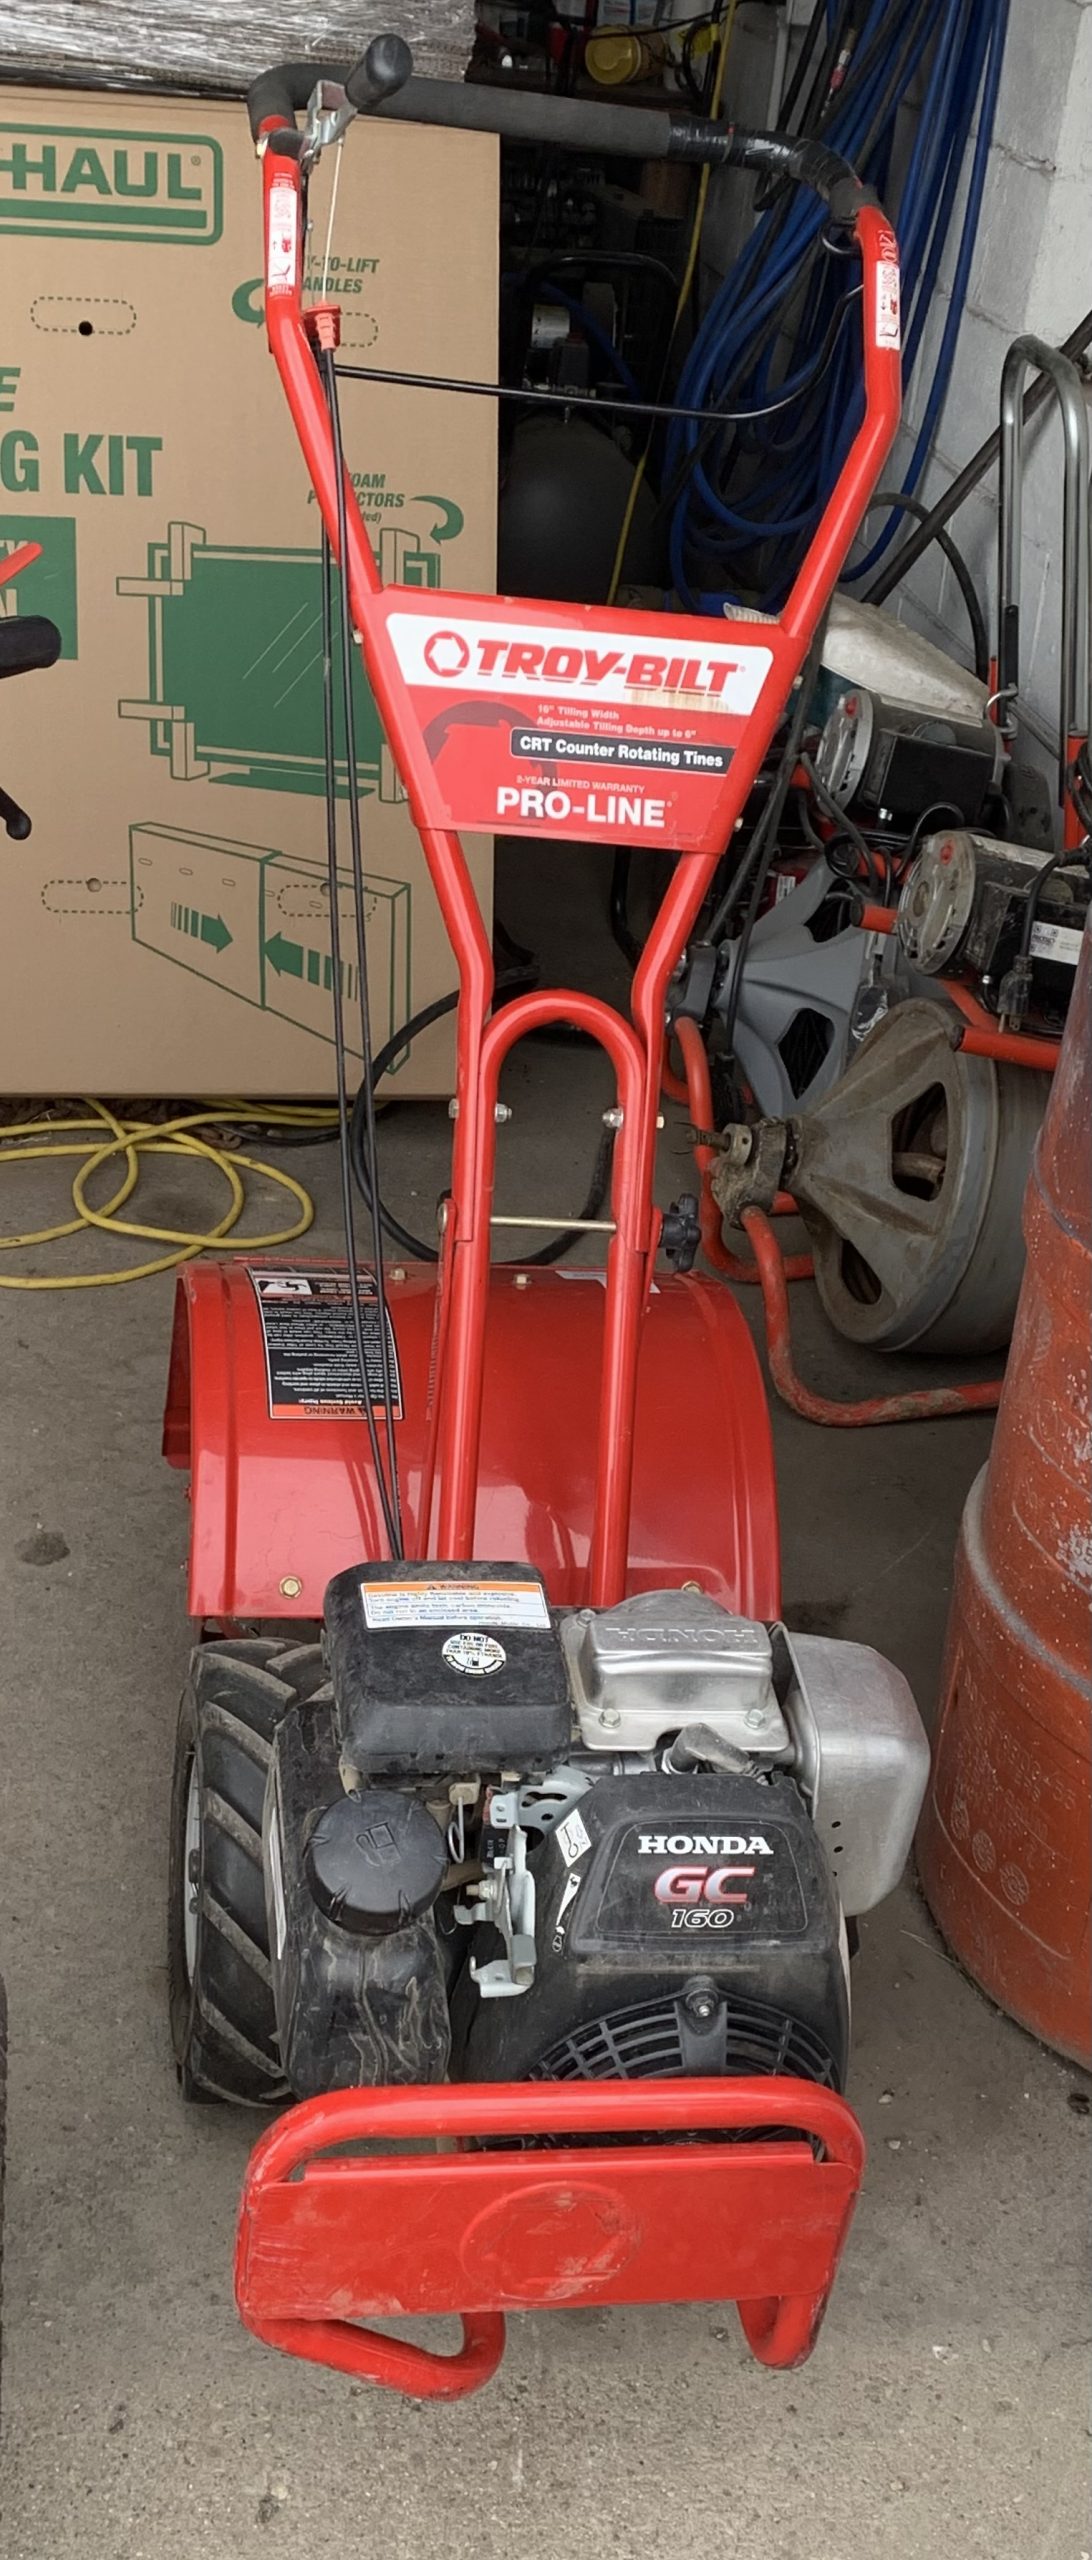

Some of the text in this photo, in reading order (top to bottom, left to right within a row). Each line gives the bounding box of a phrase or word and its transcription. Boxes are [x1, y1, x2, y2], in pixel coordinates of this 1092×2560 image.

[302, 276, 362, 293] ANDLES
[64, 433, 163, 497] KIT
[351, 473, 386, 488] OAM
[477, 639, 739, 694] TROY-BILT
[557, 705, 589, 719] Tilling
[591, 708, 620, 720] Width
[537, 716, 591, 729] Adjustable
[593, 721, 624, 734] Tilling
[625, 724, 656, 736] Depth
[657, 728, 670, 738] up
[672, 729, 683, 738] to
[520, 735, 724, 768] CRT Counter Rotating Tines
[552, 777, 590, 790] LIMITED
[592, 781, 645, 794] WARRANTY
[496, 786, 666, 829] PRO-LINE
[605, 1627, 759, 1643] HONDA
[638, 1835, 774, 1855] HONDA
[654, 1865, 756, 1905] GC
[671, 1908, 735, 1928] 160
